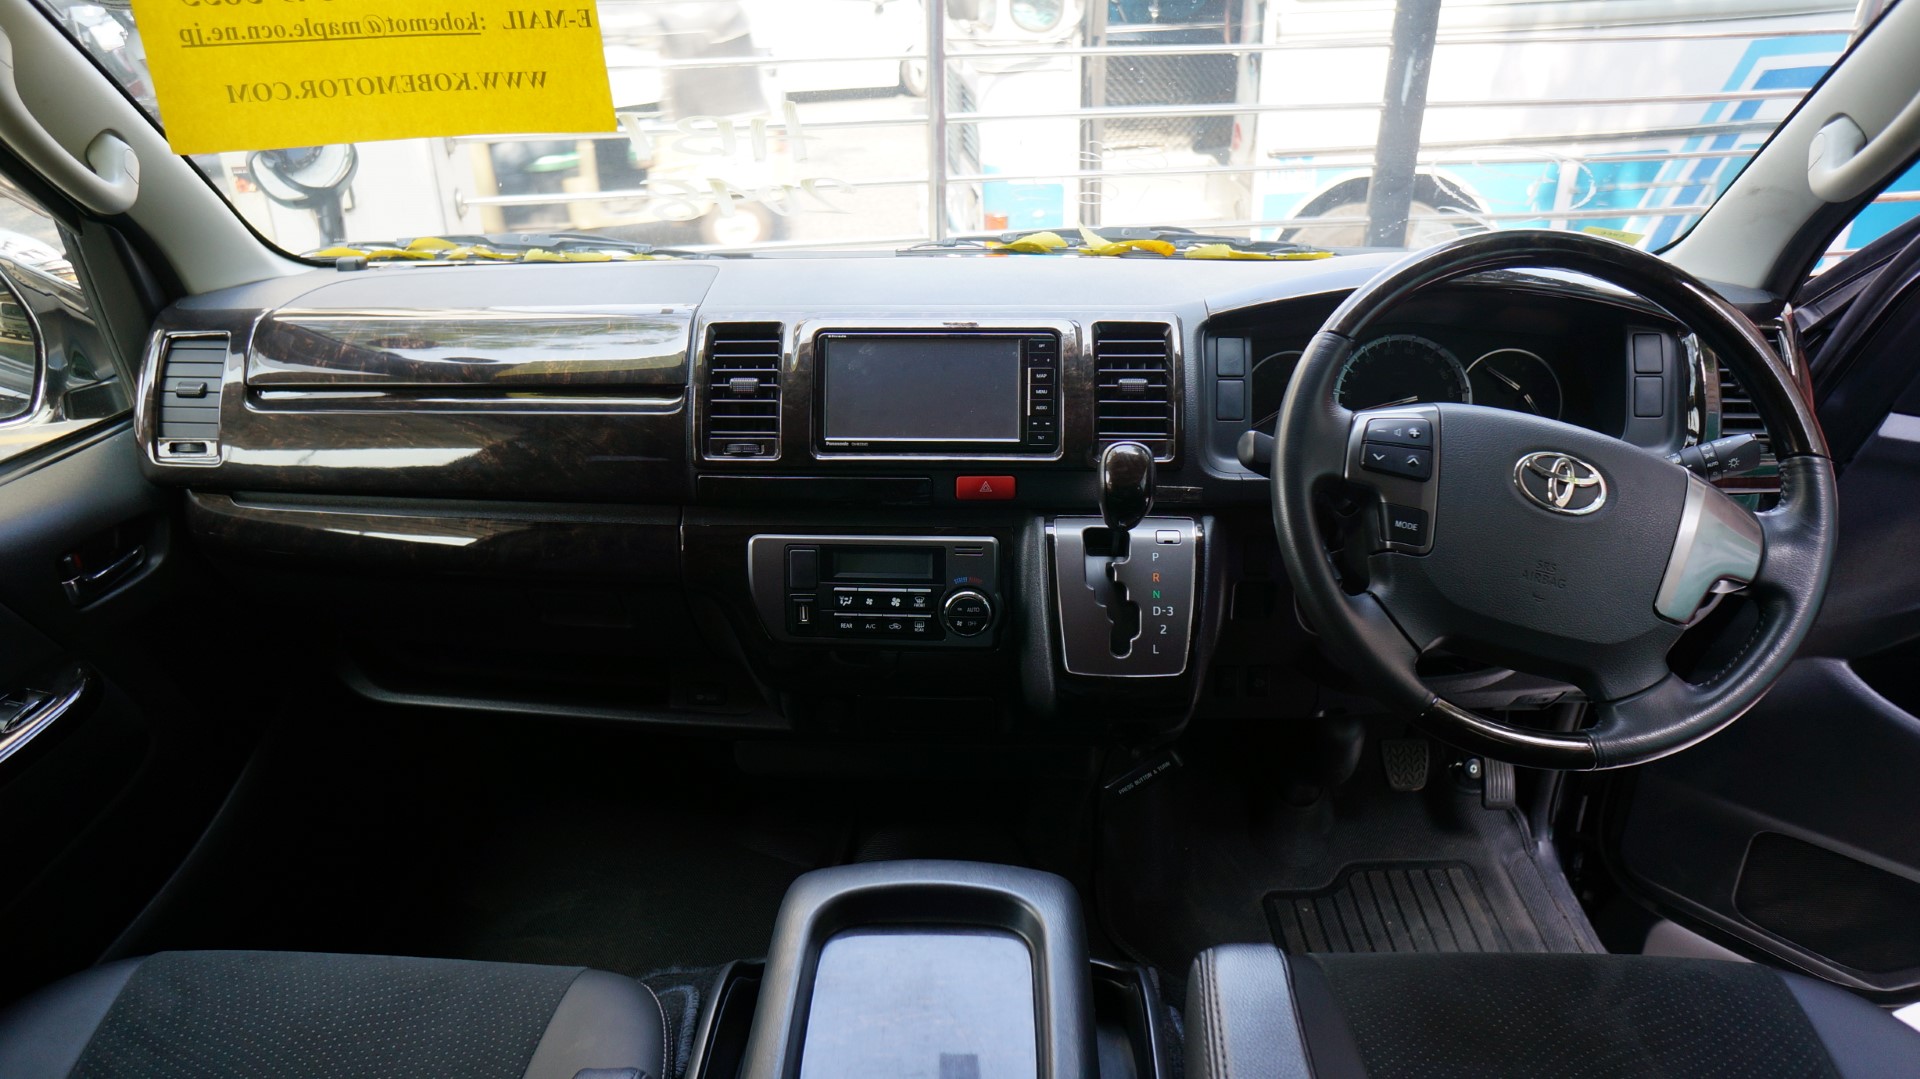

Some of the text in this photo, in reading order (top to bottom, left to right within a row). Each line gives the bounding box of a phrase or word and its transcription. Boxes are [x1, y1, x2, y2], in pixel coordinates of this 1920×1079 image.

[1706, 460, 1719, 468] AUTO
[1394, 520, 1418, 531] MODE
[1152, 552, 1159, 561] P
[1152, 572, 1160, 582] R
[1521, 569, 1567, 589] AIRBAG
[1152, 590, 1160, 599] N
[1152, 606, 1174, 616] D-3
[1160, 624, 1167, 635] 2
[1152, 644, 1159, 654] L
